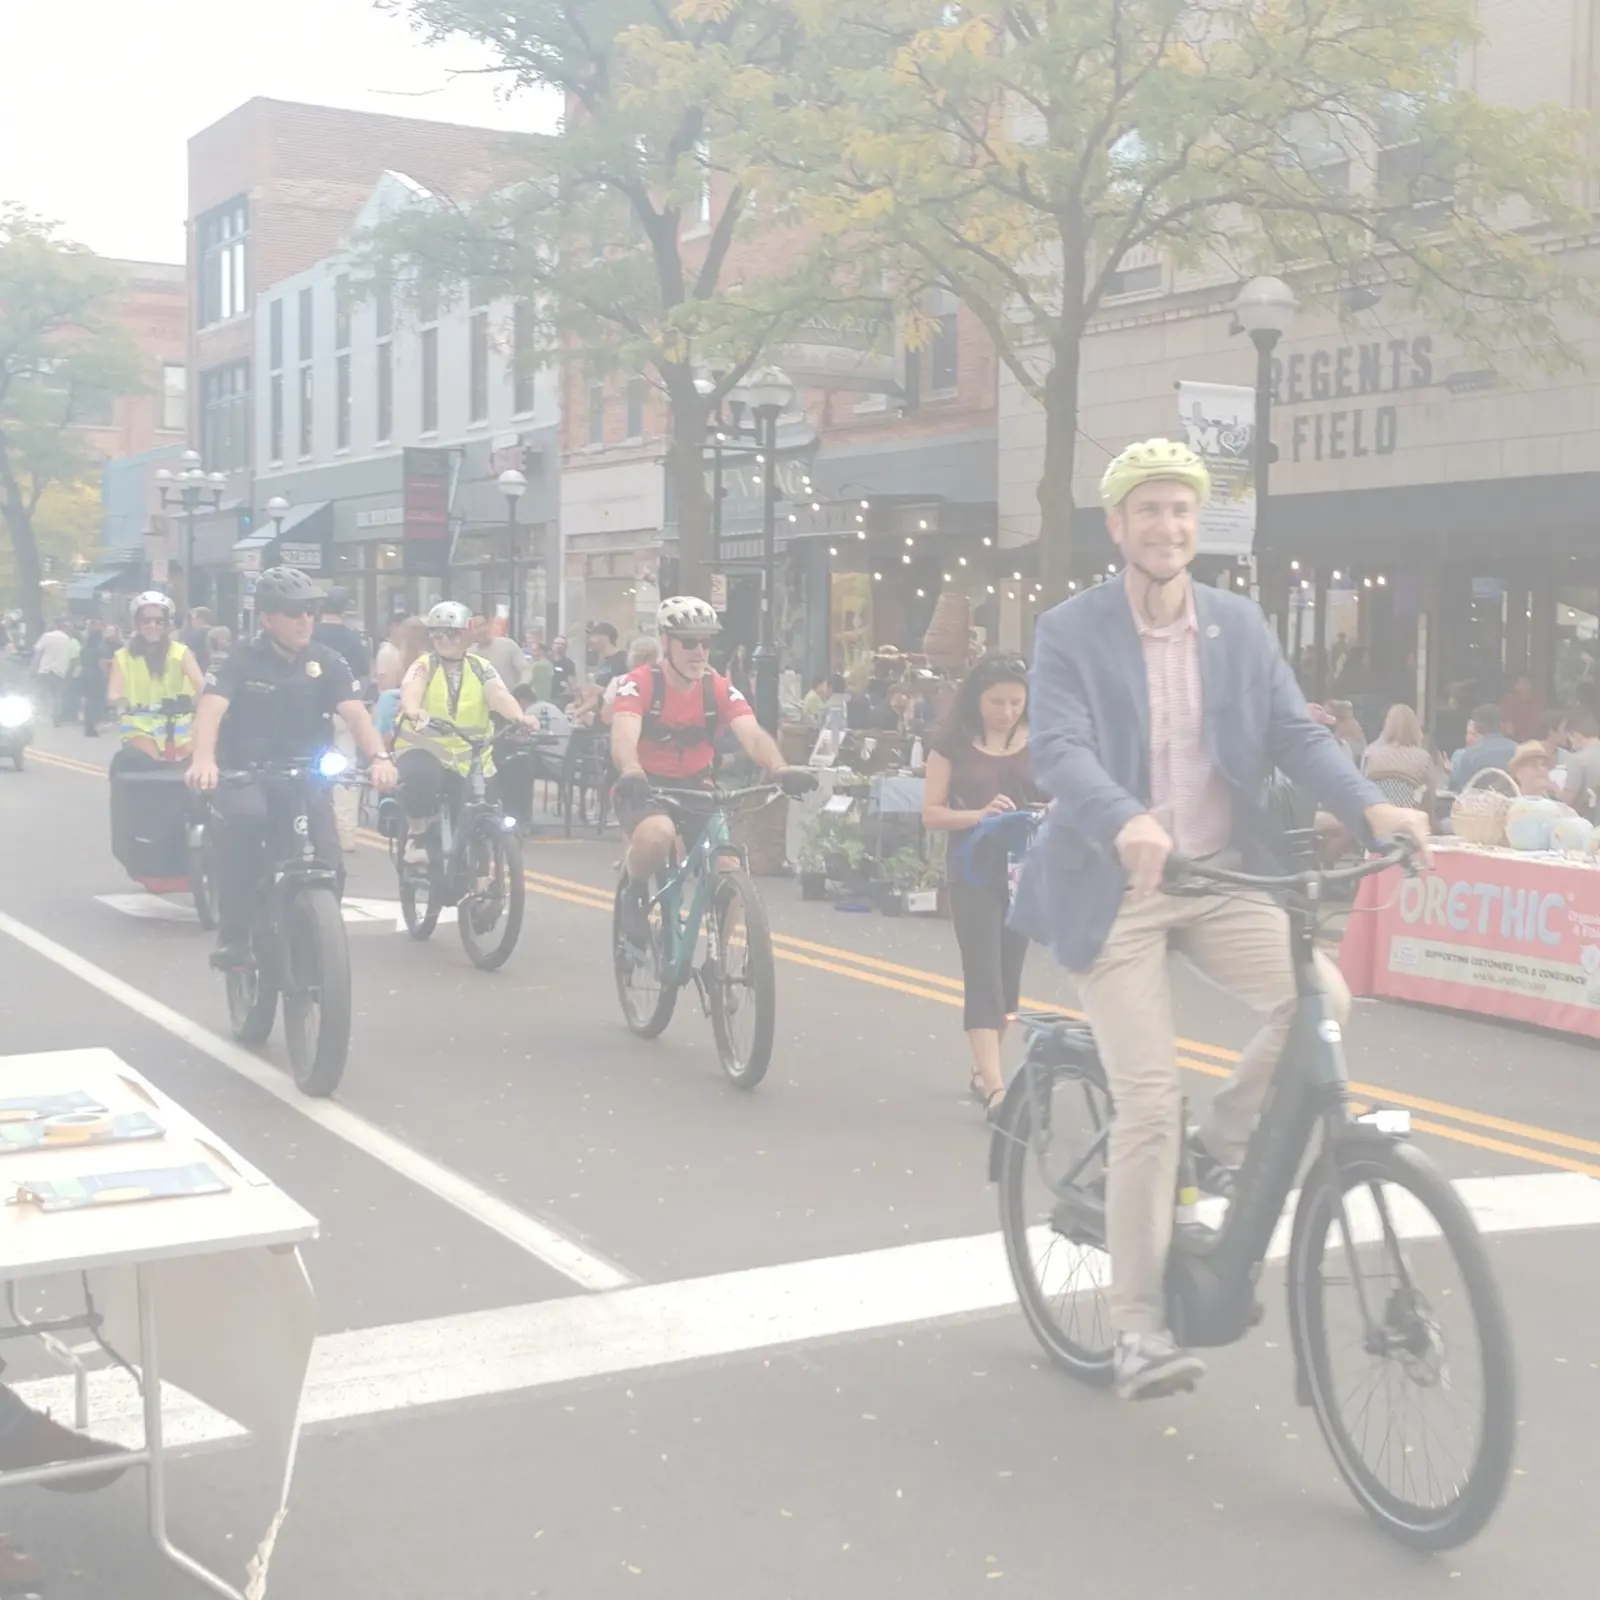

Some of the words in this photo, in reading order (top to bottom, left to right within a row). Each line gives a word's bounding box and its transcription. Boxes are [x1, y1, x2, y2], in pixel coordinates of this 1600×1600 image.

[1292, 405, 1397, 463] FIELD
[1400, 875, 1566, 946] ORETHIC
[1425, 949, 1469, 965] SUPPORTING
[1471, 956, 1513, 973] CUSTOMERS
